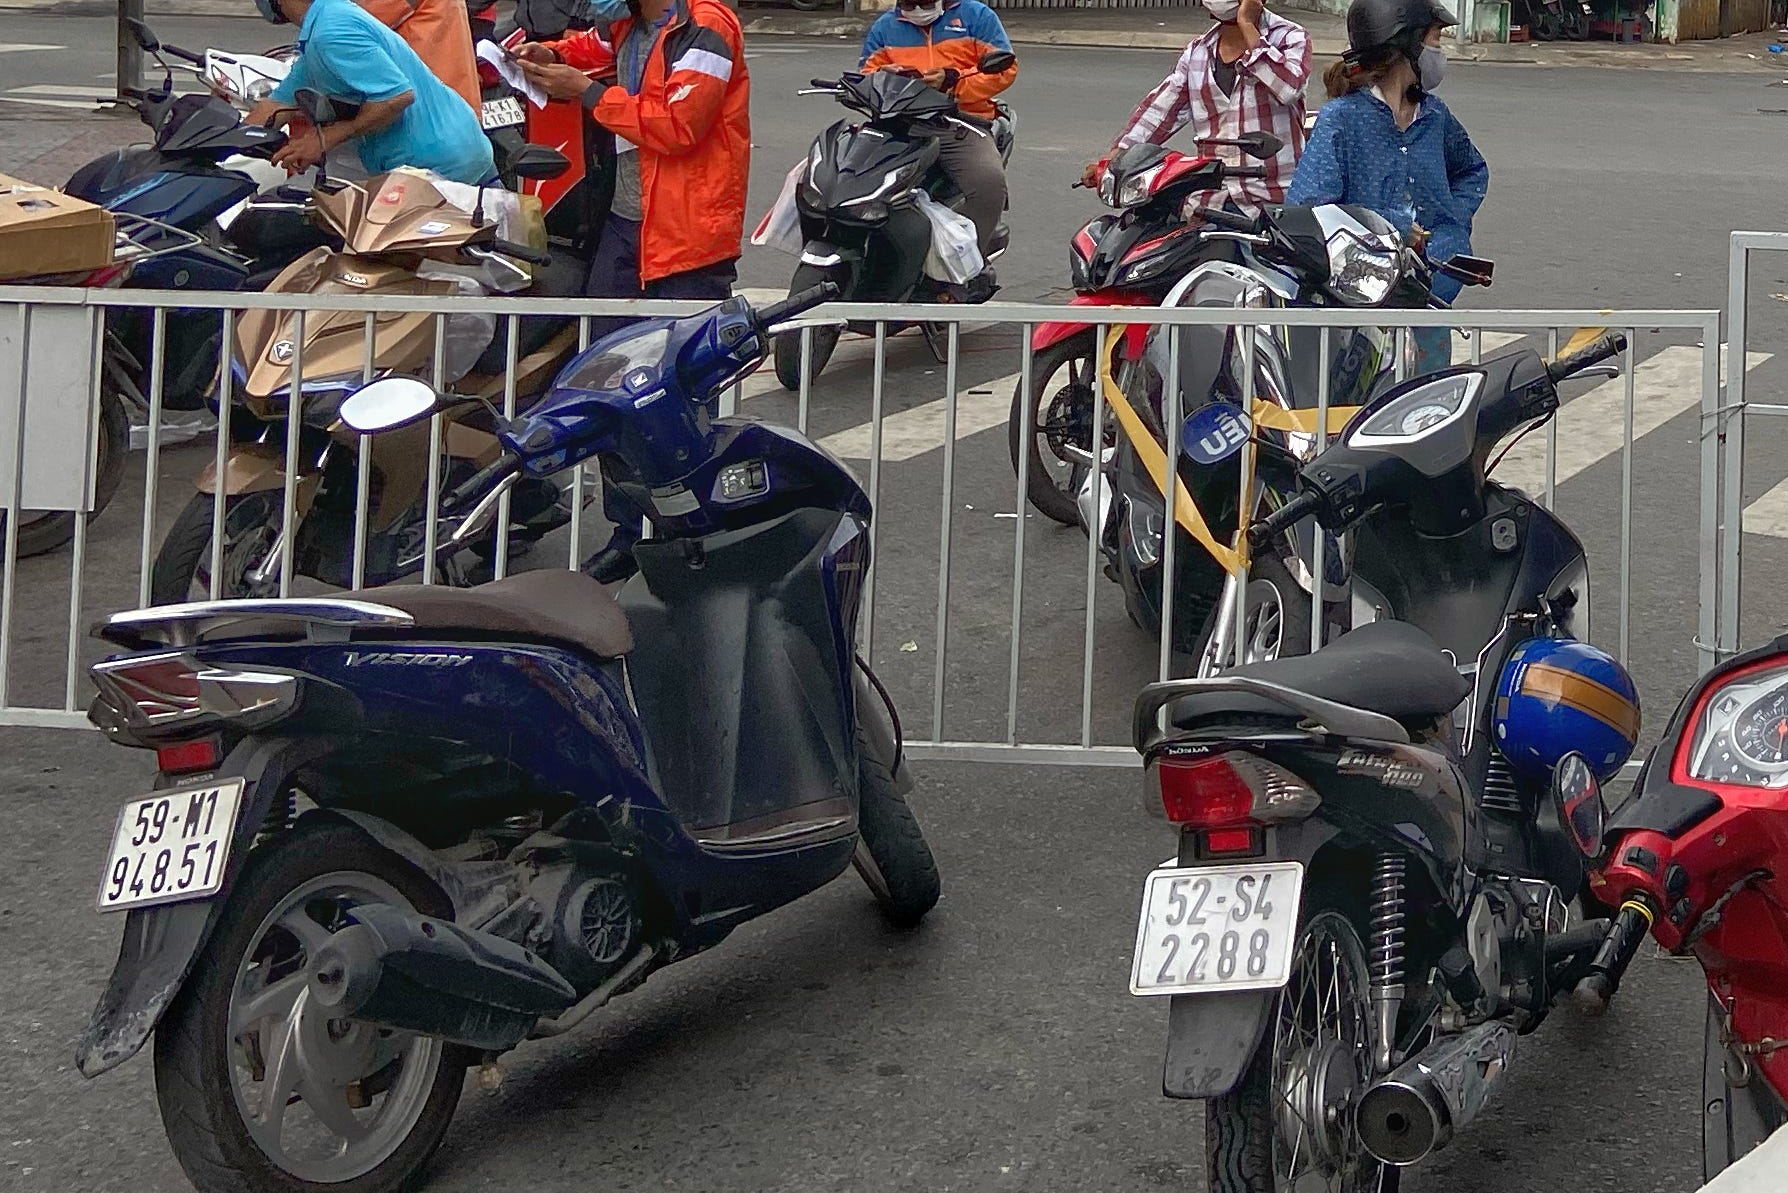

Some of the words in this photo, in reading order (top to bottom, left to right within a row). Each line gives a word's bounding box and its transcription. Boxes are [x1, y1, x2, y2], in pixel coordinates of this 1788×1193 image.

[343, 651, 474, 667] VISION
[131, 789, 221, 847] 59-M1
[107, 839, 219, 902] 948.51
[1165, 873, 1274, 927] 52-S4
[1155, 927, 1270, 985] 2288
